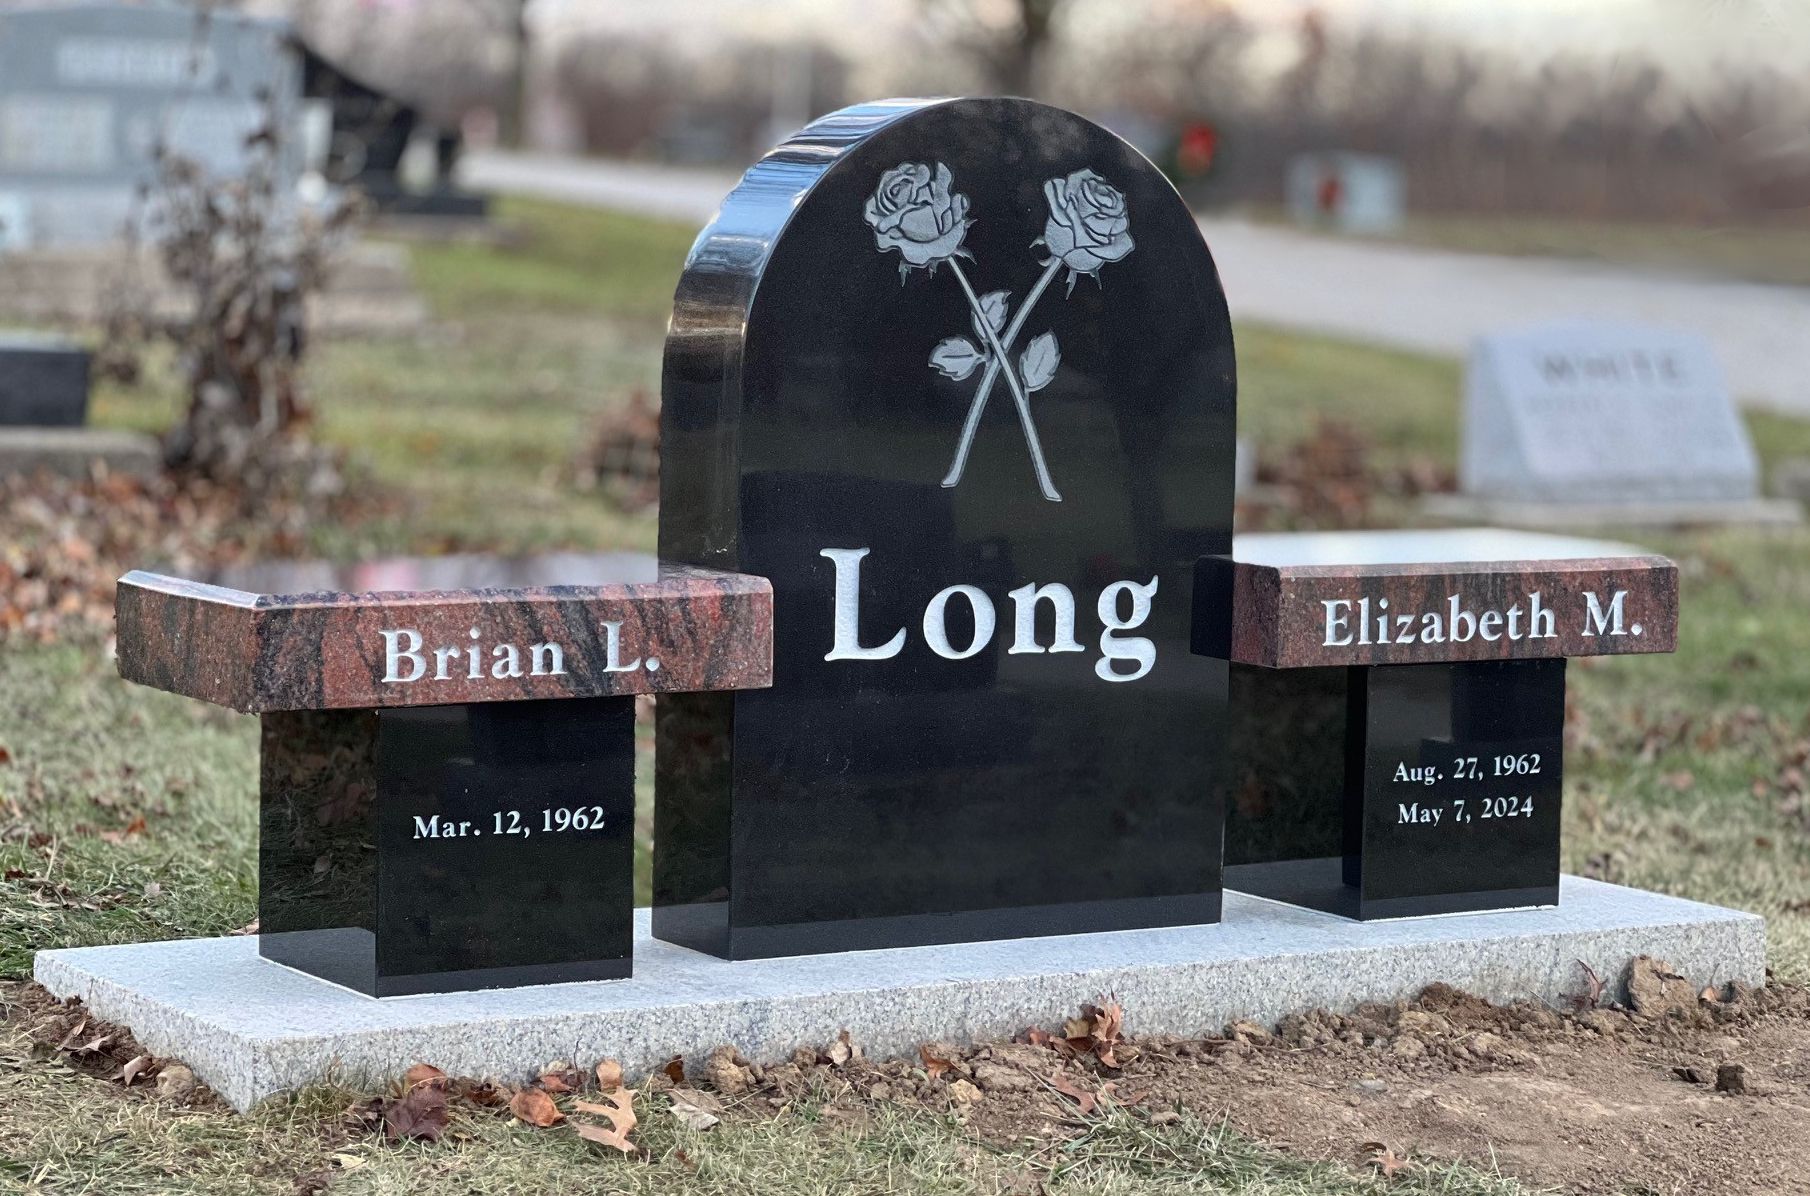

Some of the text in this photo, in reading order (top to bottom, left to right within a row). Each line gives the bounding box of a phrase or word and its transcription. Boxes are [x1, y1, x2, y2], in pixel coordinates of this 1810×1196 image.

[819, 548, 1159, 683] Long
[1320, 590, 1643, 647] Elizabeth M.
[377, 620, 660, 683] Brian L.
[1392, 753, 1541, 786] Aug. 27, 1962
[412, 806, 605, 840] Mar. 12, 1962
[1397, 796, 1534, 827] May 7, 2024
